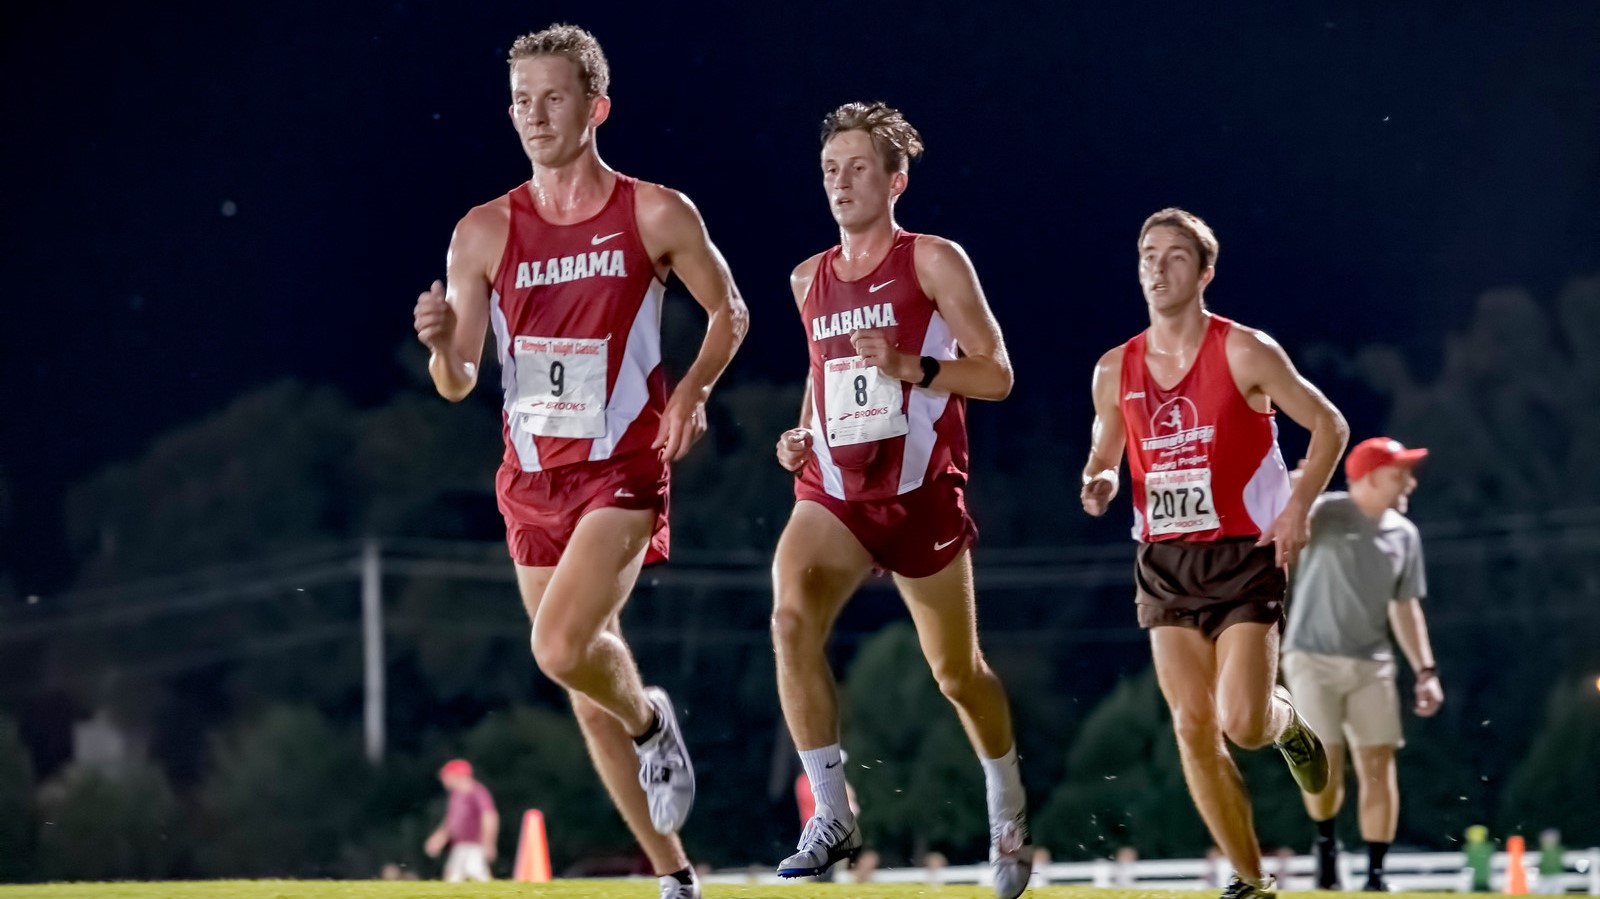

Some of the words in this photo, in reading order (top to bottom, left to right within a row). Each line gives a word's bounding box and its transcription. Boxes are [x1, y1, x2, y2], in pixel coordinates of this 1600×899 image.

[515, 250, 627, 289] ALABAMA
[812, 303, 897, 341] ALABAMA
[550, 360, 565, 397] 9
[854, 375, 868, 407] 8
[546, 402, 587, 411] BROOKS
[854, 407, 888, 419] BROOKS
[1150, 486, 1210, 520] 2072
